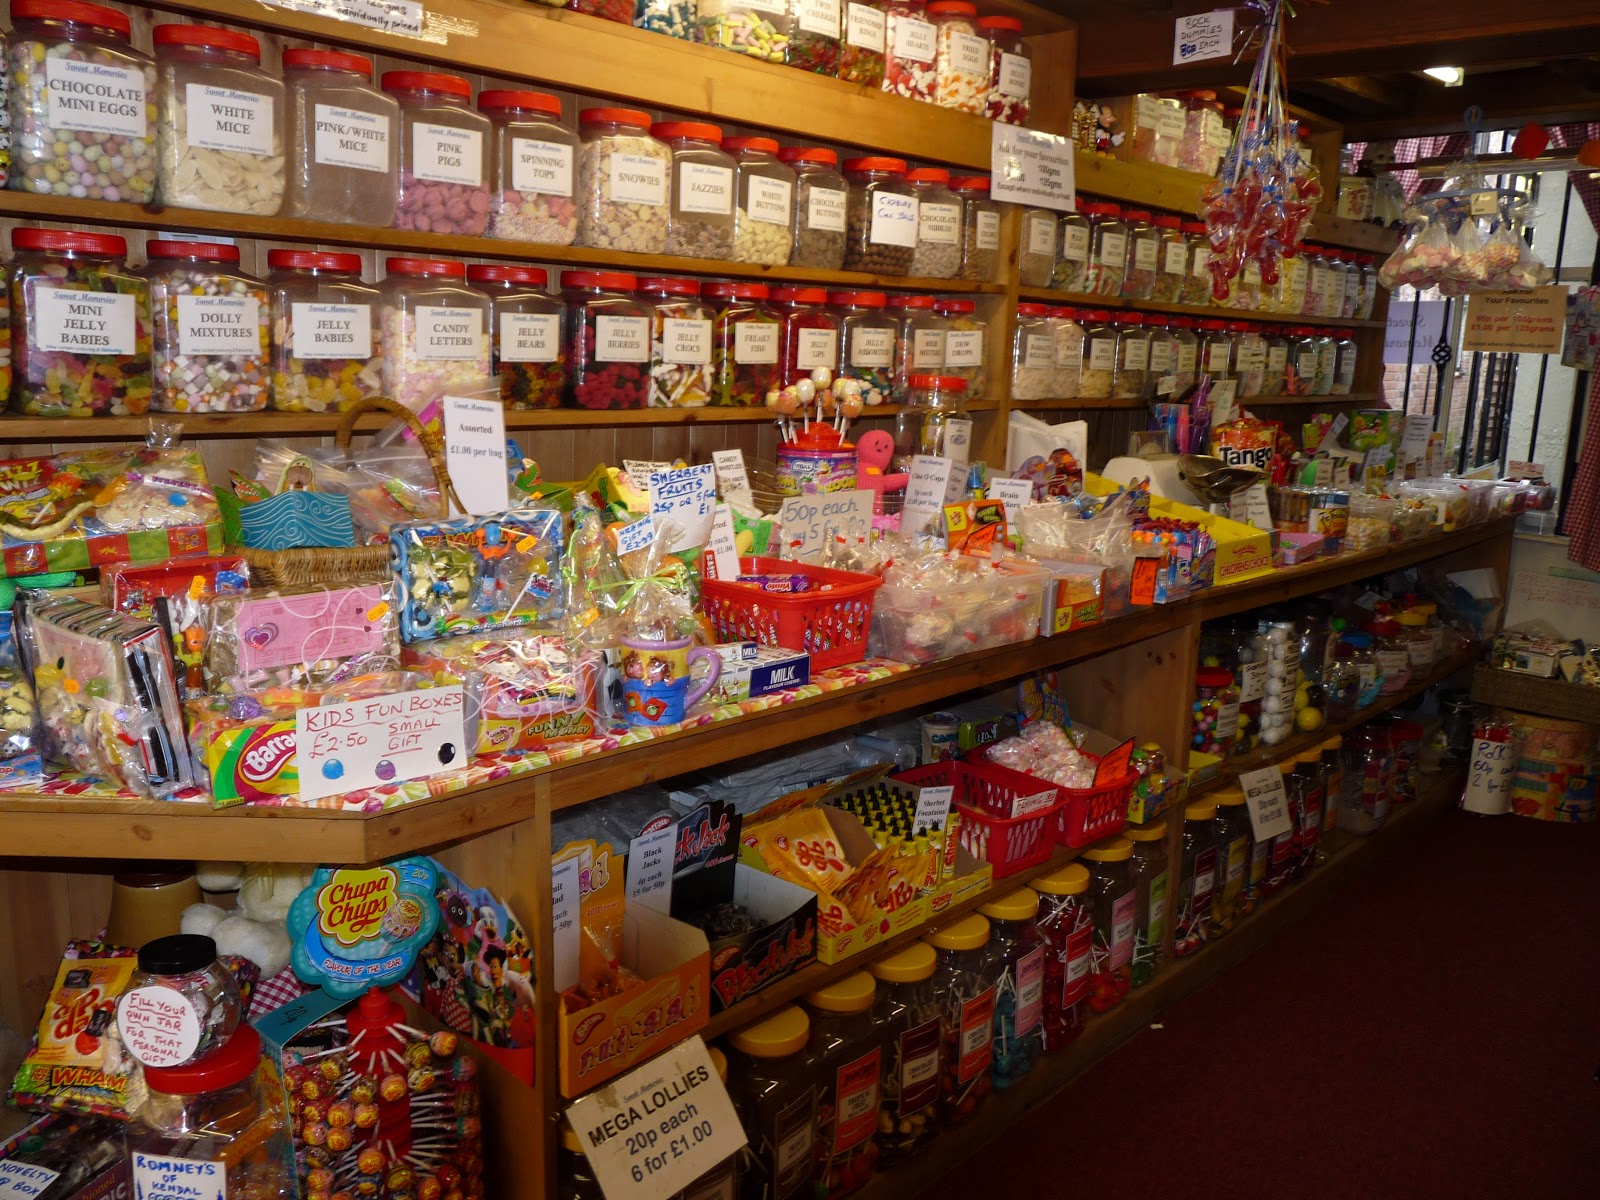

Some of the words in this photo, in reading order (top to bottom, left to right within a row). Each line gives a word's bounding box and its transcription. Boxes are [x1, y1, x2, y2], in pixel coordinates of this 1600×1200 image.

[391, 20, 421, 33] priced
[850, 14, 884, 30] FRIENDSHIP
[1185, 16, 1210, 28] ROCK
[859, 26, 877, 38] RINGS
[1181, 24, 1222, 39] DUMMIES
[1199, 40, 1219, 50] EACH
[65, 61, 89, 75] Sweet
[89, 65, 128, 80] Memories
[49, 78, 143, 102] CHOCOLATE
[58, 97, 95, 113] MINI
[99, 102, 138, 118] EGGS
[211, 103, 255, 121] WHITE
[215, 119, 251, 135] MICE
[316, 120, 387, 143] PINK/WHITE
[338, 140, 368, 153] MICE
[436, 142, 462, 155] PINK
[437, 155, 462, 168] PIGS
[520, 153, 565, 169] SPINNING
[533, 168, 556, 180] TOPS
[618, 172, 661, 187] SNOWIES
[691, 182, 725, 195] JAZZIES
[755, 200, 786, 213] BUTTONS
[809, 196, 846, 209] CHOCOLATE
[815, 208, 842, 219] BUTTONS
[53, 290, 77, 302] Sweet
[78, 292, 116, 305] Memories
[68, 303, 103, 317] MINI
[63, 318, 107, 332] JELLY
[201, 312, 243, 324] DOLLY
[316, 319, 351, 331] JELLY
[189, 327, 253, 339] MIXTURES
[433, 323, 470, 334] CANDY
[517, 327, 545, 338] JELLY
[612, 328, 637, 338] JELLY
[60, 332, 110, 346] BABIES
[314, 332, 354, 343] BABIES
[429, 336, 473, 347] LETTERS
[516, 339, 546, 350] BEARS
[607, 339, 641, 350] BERRIES
[677, 333, 700, 343] JELLY
[674, 344, 701, 353] CROCS
[458, 423, 493, 434] Assorted
[450, 445, 472, 455] £1.00
[473, 449, 486, 458] per
[488, 449, 503, 459] bag
[1219, 446, 1273, 469] Tango
[650, 464, 713, 487] SHERBERT
[657, 478, 703, 500] FRUITS
[679, 497, 692, 507] OR
[696, 491, 702, 502] 5
[698, 502, 710, 516] £1
[785, 501, 817, 524] 50p
[621, 530, 642, 545] GIFT
[809, 523, 820, 539] 5
[472, 617, 523, 631] Refreshers
[742, 647, 757, 658] MILK
[770, 665, 796, 685] MILK
[762, 682, 784, 691] FLAVOUR
[305, 708, 354, 733] KIDS
[365, 700, 403, 721] FUN
[409, 692, 463, 712] BOXES
[528, 709, 587, 736] FUNNY
[308, 732, 368, 759] £2.50
[388, 718, 441, 735] SMALL
[544, 726, 590, 739] MONEY
[388, 734, 422, 751] GIFT
[243, 732, 297, 773] Barra
[923, 799, 946, 807] Sherbet
[1016, 795, 1043, 810] FLYING
[917, 819, 928, 828] Dip
[692, 812, 730, 853] Jack
[643, 846, 663, 859] Black
[642, 856, 662, 869] Jacks
[410, 867, 429, 881] 20p
[637, 875, 647, 886] 4p
[648, 870, 663, 883] each
[328, 875, 389, 905] Chupa
[642, 884, 652, 896] for
[652, 880, 665, 893] 50p
[327, 893, 389, 933] Chups
[323, 958, 352, 975] FLAVOUR
[353, 965, 365, 975] OF
[366, 963, 381, 974] THE
[129, 992, 155, 1007] FILL
[156, 1000, 187, 1017] YOUR
[126, 1010, 151, 1023] OWN
[157, 1017, 182, 1032] JAR
[126, 1025, 146, 1040] FOR
[154, 1034, 183, 1048] THAT
[133, 1039, 181, 1059] PERSONAL
[141, 1052, 166, 1065] GIFT
[51, 1067, 128, 1093] WHAM
[588, 1106, 643, 1148] MEGA
[644, 1065, 710, 1116] LOLLIES
[624, 1128, 659, 1156] 20p
[660, 1102, 699, 1135] each
[630, 1164, 645, 1184] 6
[644, 1150, 669, 1175] for
[670, 1120, 713, 1159] £1.00
[0, 1162, 55, 1183] NOVELTY
[136, 1156, 217, 1176] ROMNEY'S
[163, 1174, 177, 1184] OF
[12, 1180, 40, 1197] BOX
[151, 1181, 202, 1196] KENDAL
